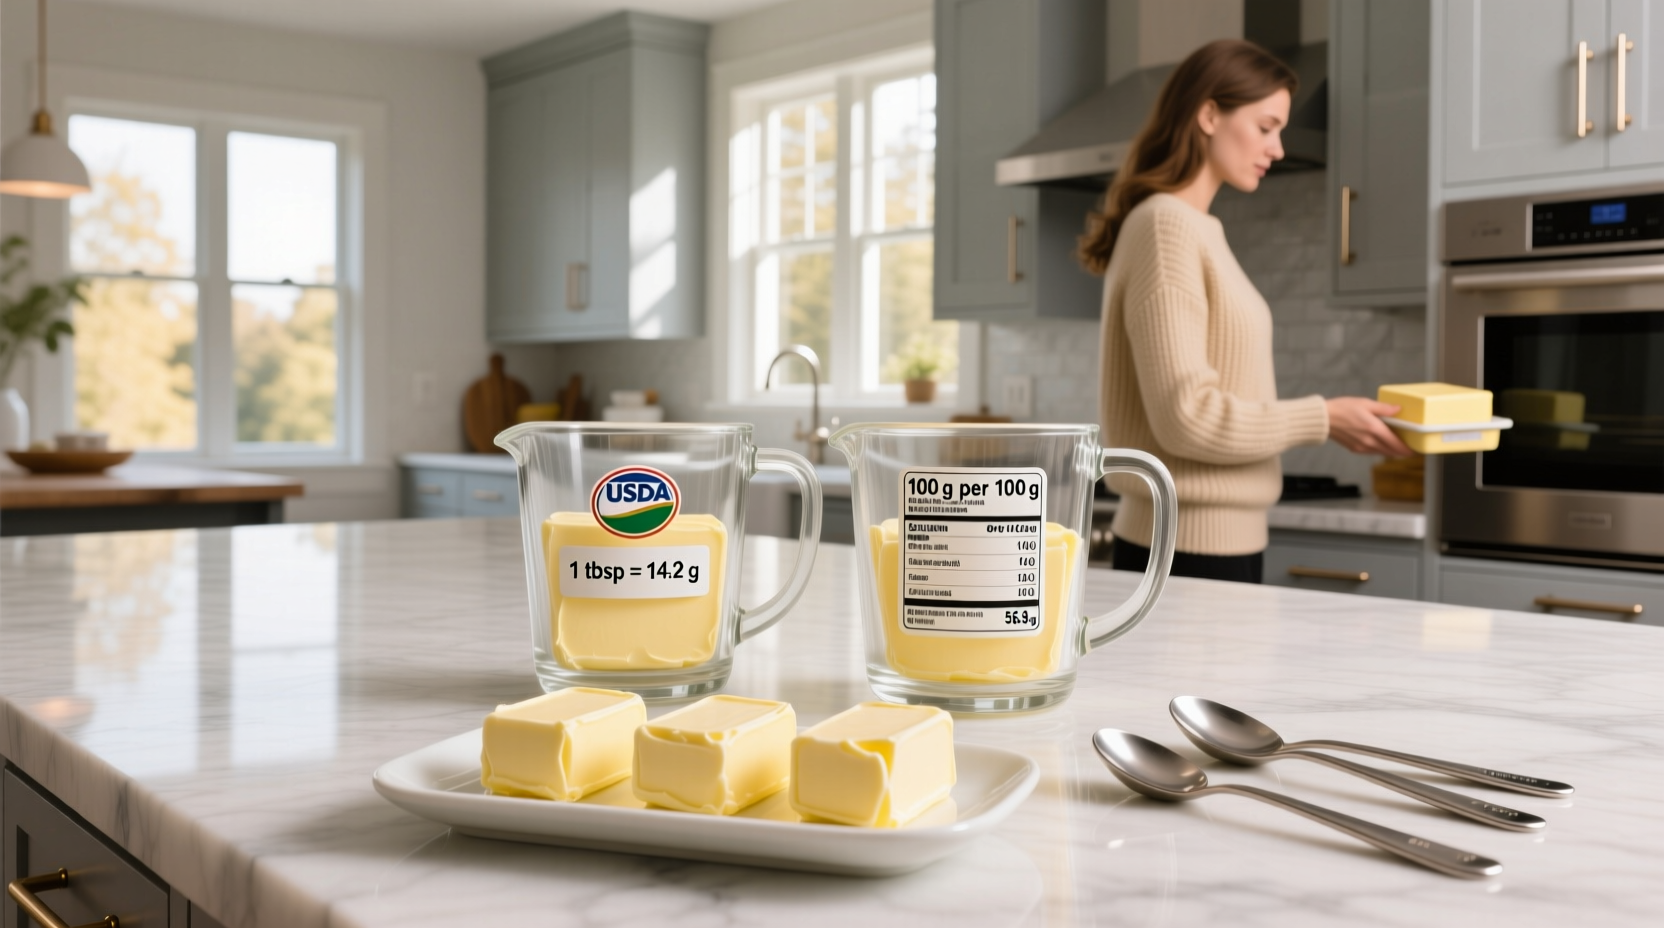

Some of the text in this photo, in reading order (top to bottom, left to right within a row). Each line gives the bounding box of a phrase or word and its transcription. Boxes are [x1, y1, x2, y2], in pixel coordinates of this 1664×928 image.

[606, 481, 672, 503] USDA
[908, 477, 1039, 501] 100 g per 100 g
[569, 560, 700, 584] 1 tbsp = 14.2 g
